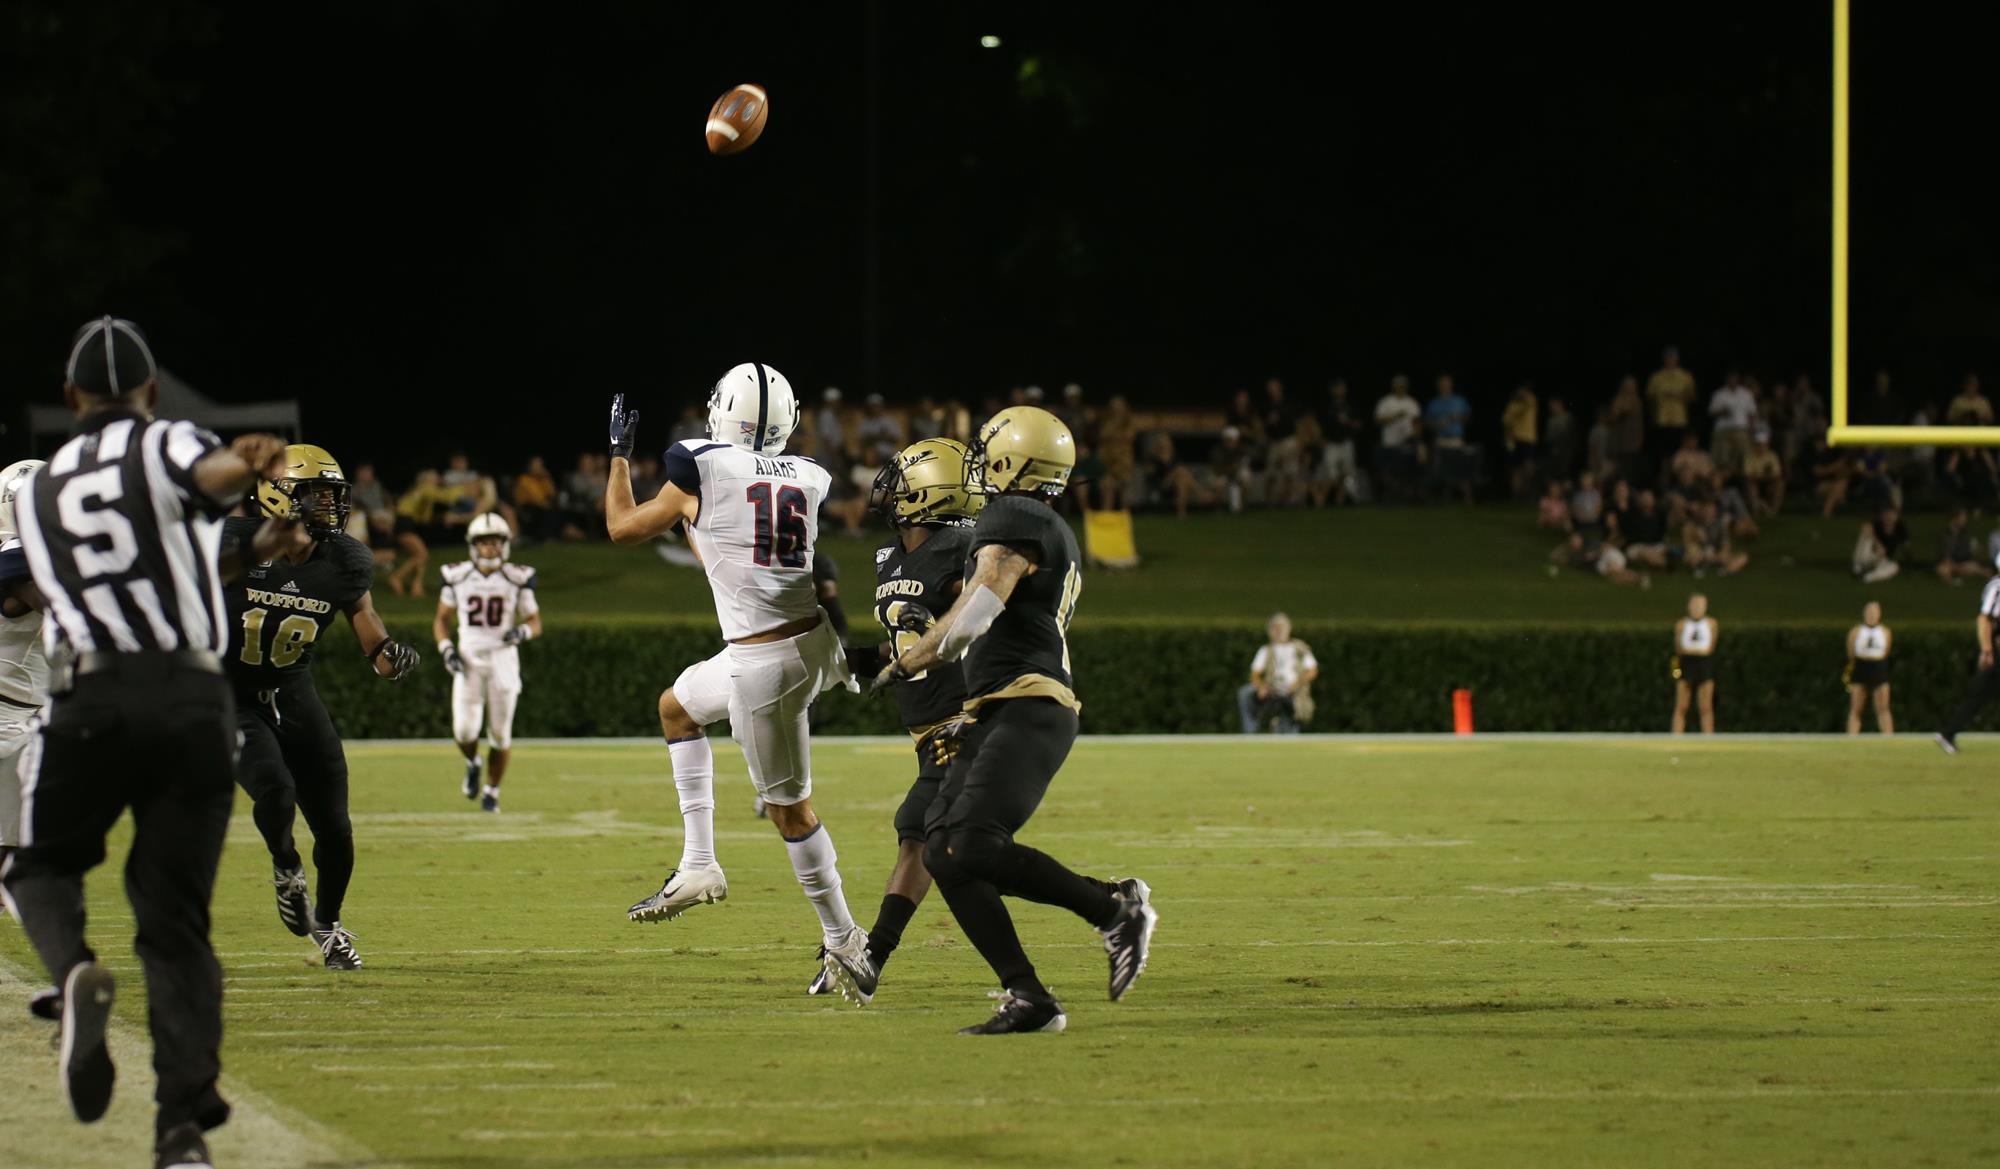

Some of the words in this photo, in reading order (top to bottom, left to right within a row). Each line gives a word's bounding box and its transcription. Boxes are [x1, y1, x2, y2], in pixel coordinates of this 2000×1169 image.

[755, 457, 798, 479] ADAMS
[57, 465, 139, 578] S
[746, 482, 808, 569] 16
[246, 587, 332, 614] WOFFORD
[468, 595, 503, 627] 20
